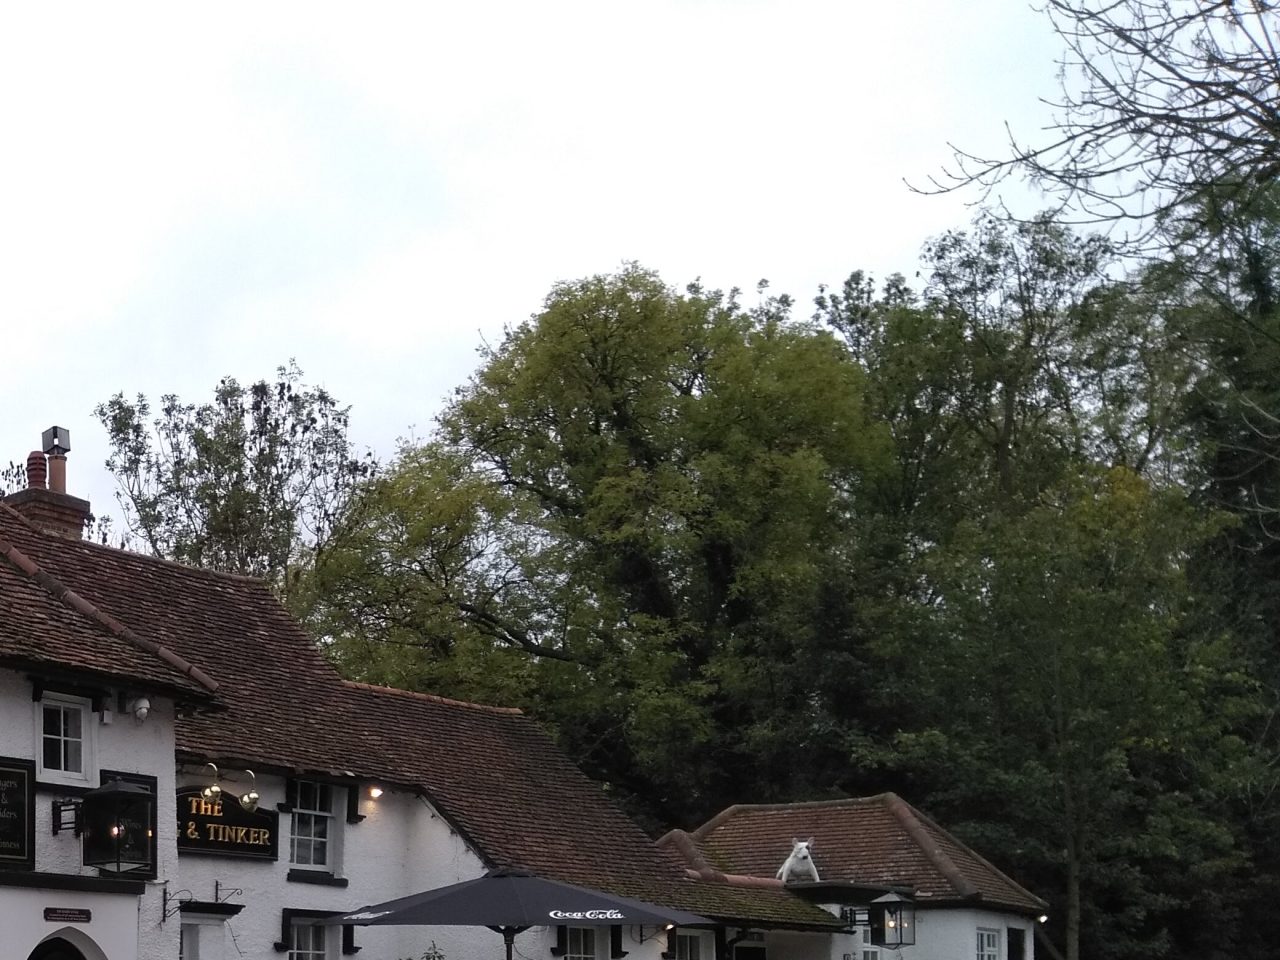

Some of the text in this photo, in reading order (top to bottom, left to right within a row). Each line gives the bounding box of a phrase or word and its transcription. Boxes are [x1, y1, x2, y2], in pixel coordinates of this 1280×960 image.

[188, 797, 223, 816] THE
[187, 821, 200, 839] &
[206, 823, 271, 845] TINKER
